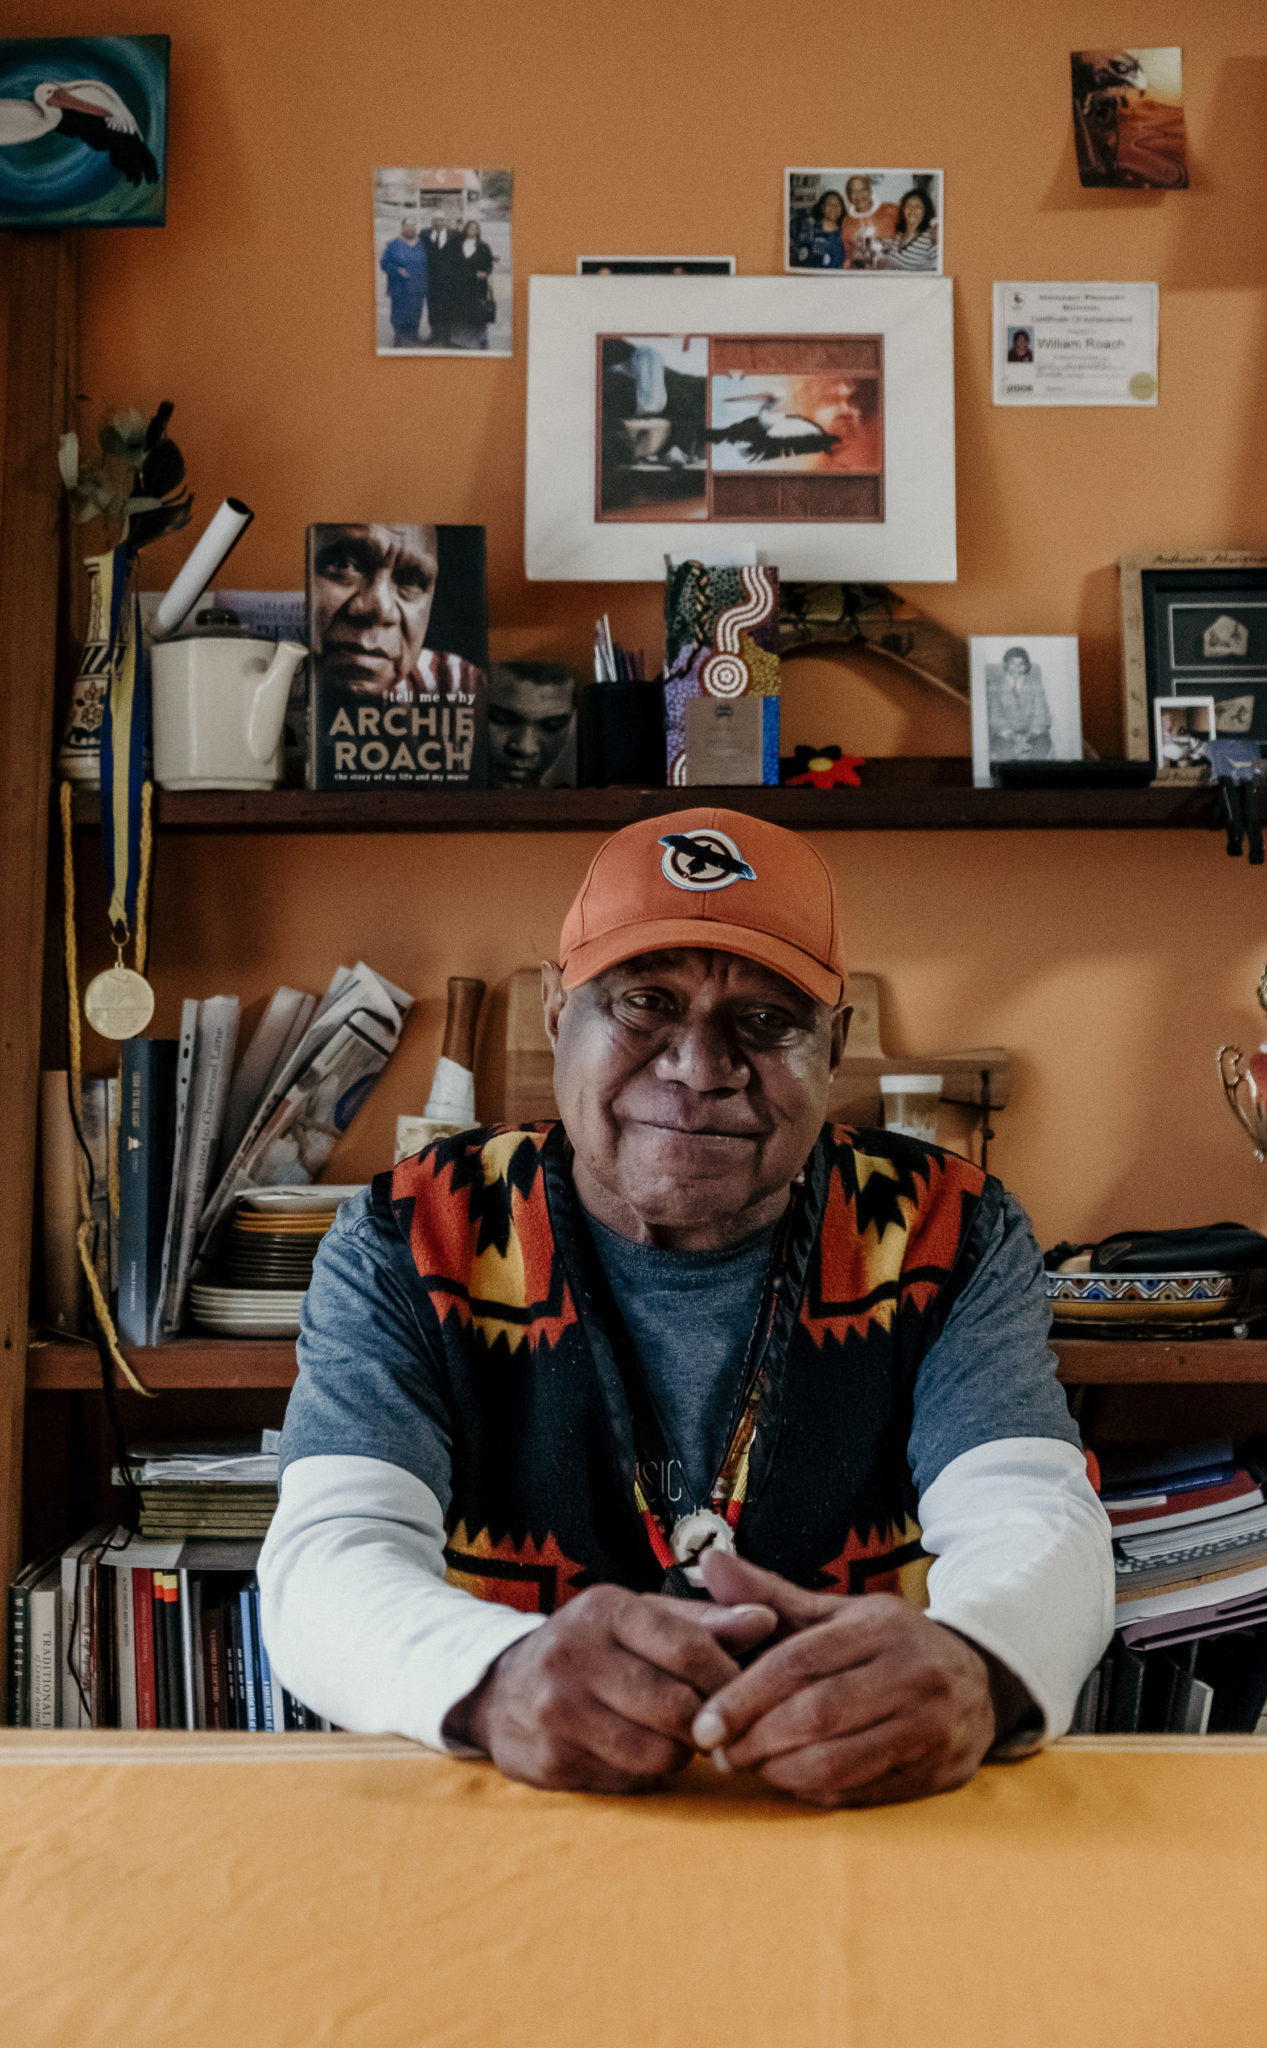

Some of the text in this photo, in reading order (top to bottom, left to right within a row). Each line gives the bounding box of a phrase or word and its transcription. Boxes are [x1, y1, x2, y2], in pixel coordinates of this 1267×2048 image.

[1037, 338, 1126, 349] William Roach
[389, 690, 476, 705] tell me why
[328, 706, 475, 737] ARCHIE
[334, 741, 472, 771] ROACH
[334, 772, 469, 782] the story of my life and my music
[210, 1027, 224, 1060] Lane
[200, 1064, 219, 1125] Charcoal
[198, 1127, 211, 1141] to
[14, 1597, 23, 1677] WIMMERA
[34, 1665, 43, 1695] Central
[42, 1631, 52, 1719] TRADITIONAL
